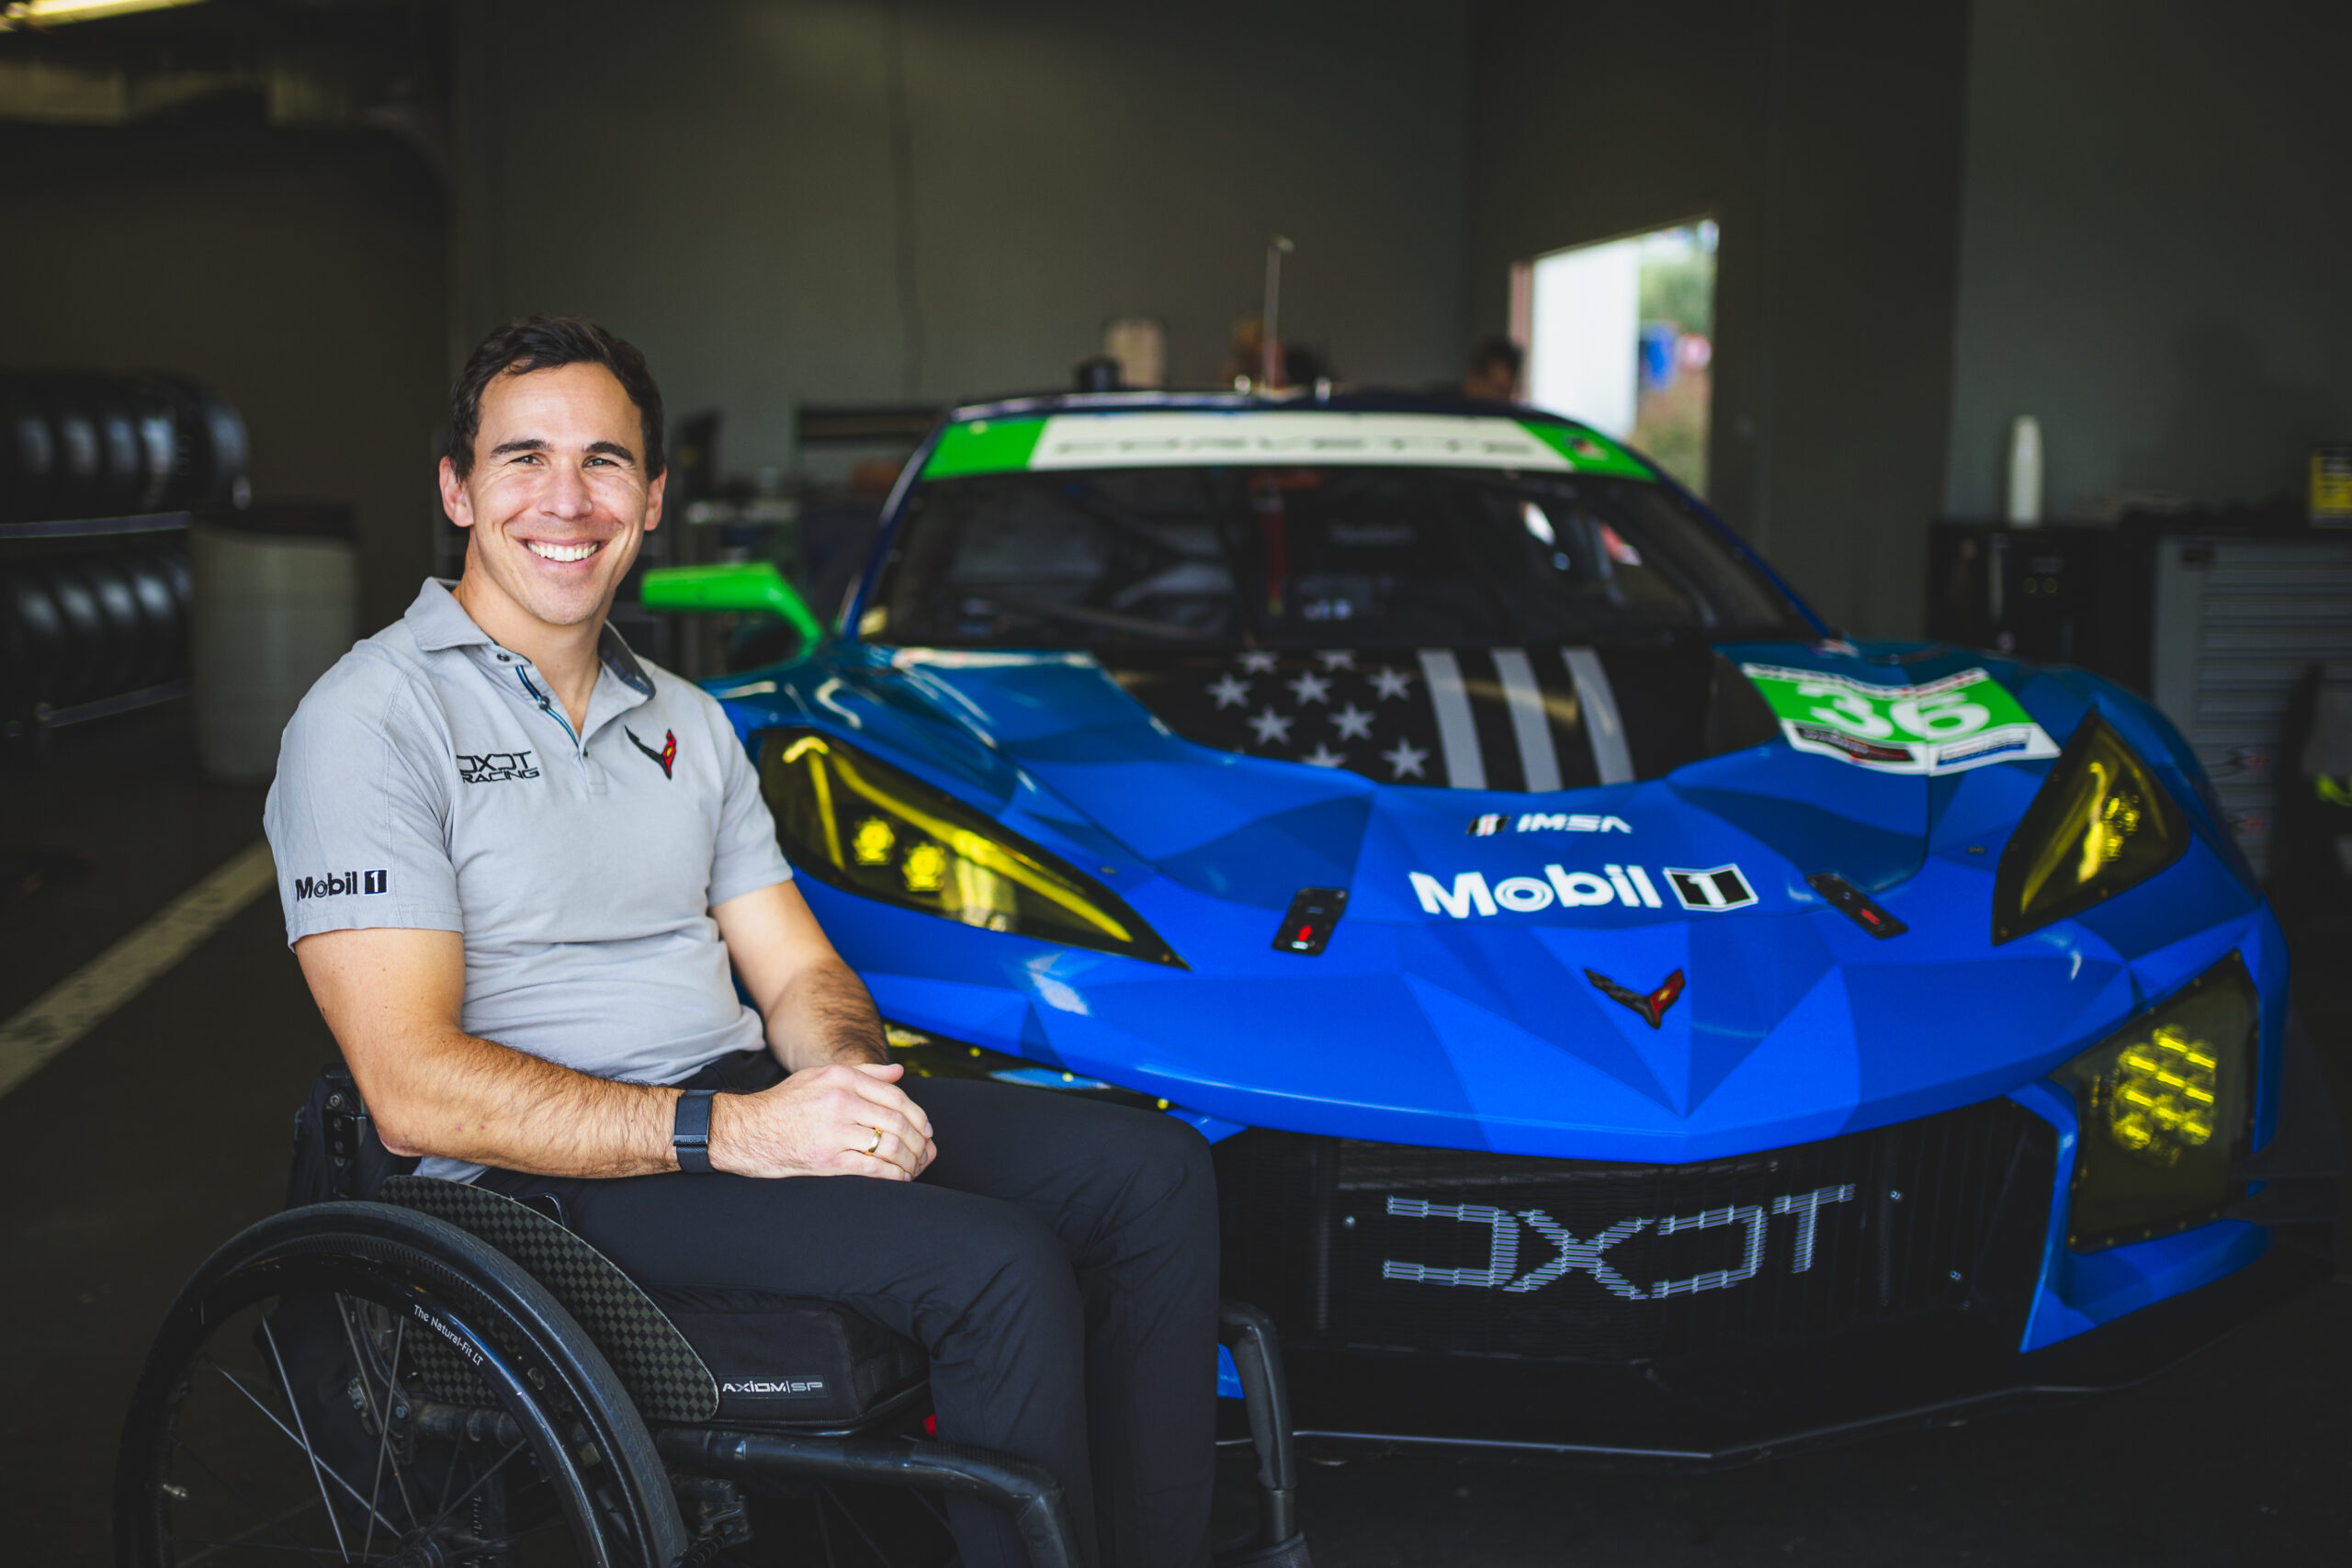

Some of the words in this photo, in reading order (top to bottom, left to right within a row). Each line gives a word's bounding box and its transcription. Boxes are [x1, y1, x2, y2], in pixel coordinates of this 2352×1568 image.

[1797, 682, 1990, 740] 36
[460, 767, 540, 784] RACING
[1516, 813, 1633, 834] IMSA
[295, 871, 358, 902] Mobil
[1408, 863, 1662, 919] Mobil
[414, 1304, 429, 1321] The
[431, 1316, 472, 1358] Natural-Fit
[472, 1352, 484, 1366] LT
